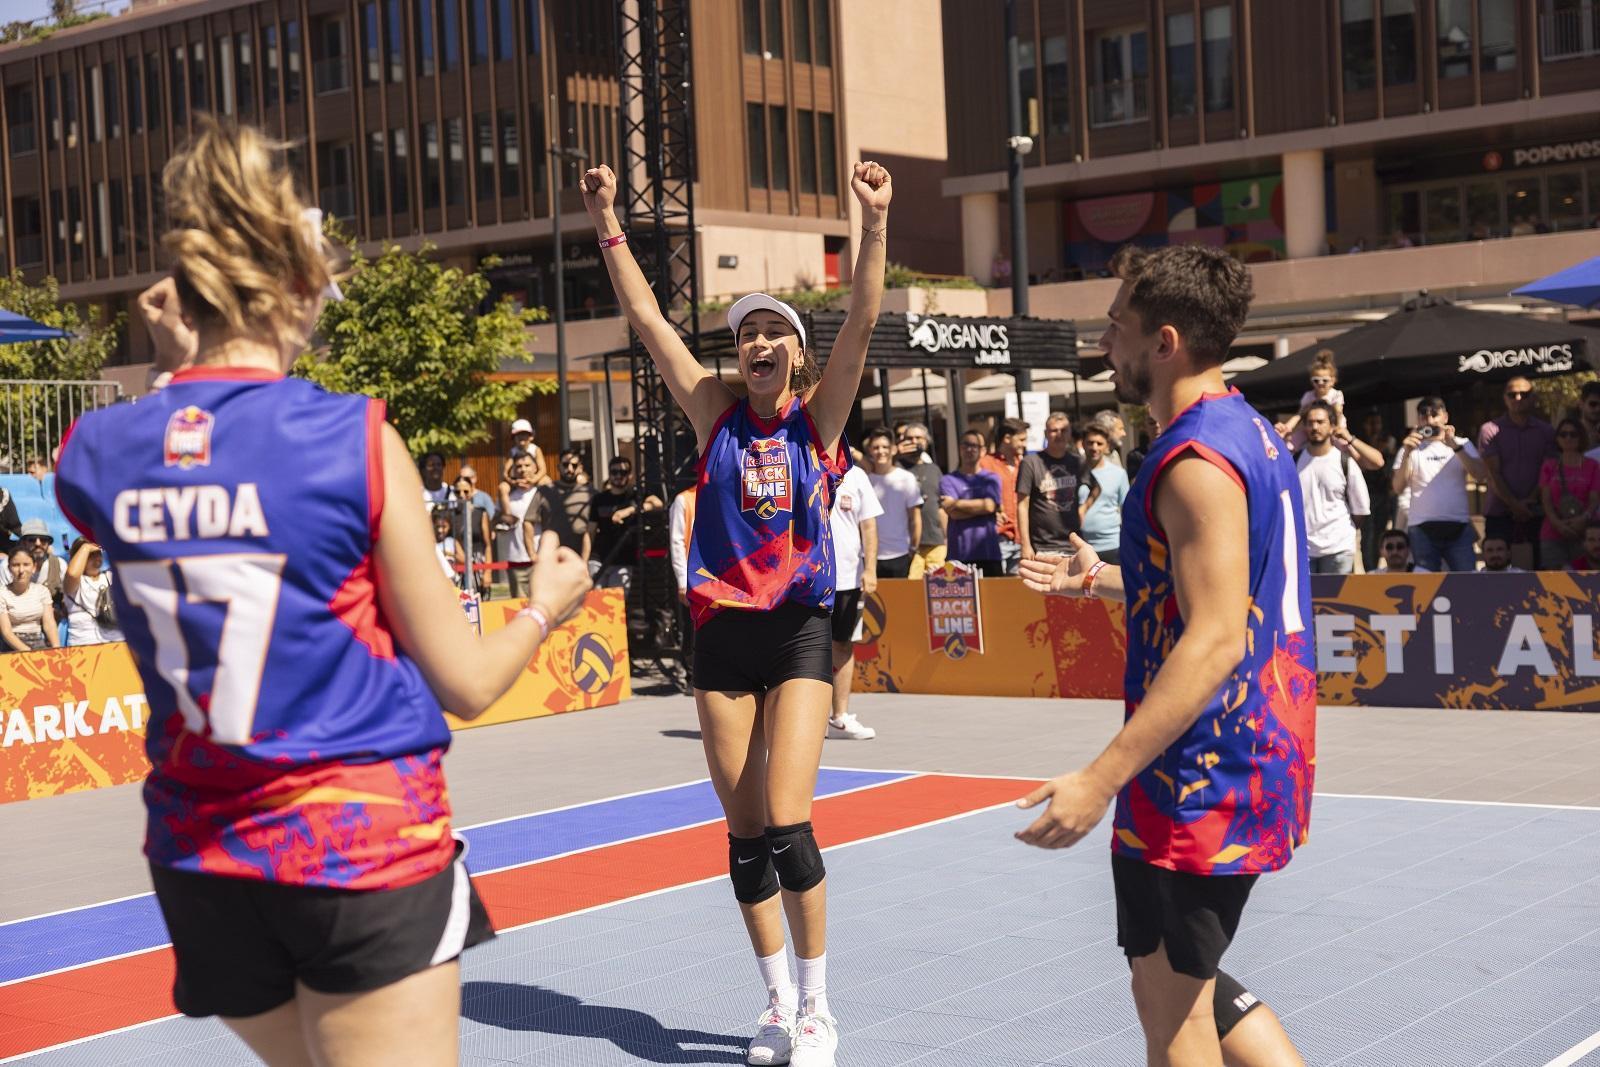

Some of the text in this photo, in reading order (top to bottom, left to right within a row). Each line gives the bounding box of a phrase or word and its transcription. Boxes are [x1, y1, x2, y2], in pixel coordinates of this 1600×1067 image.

[918, 318, 1009, 352] ORGANICS
[1473, 343, 1573, 373] ORGANICS
[764, 451, 786, 465] Bull
[747, 466, 786, 482] BACK
[746, 481, 787, 497] LINE
[113, 482, 271, 544] CEYDA
[931, 600, 972, 616] BACK
[933, 616, 975, 635] LINE
[0, 699, 95, 748] ARK
